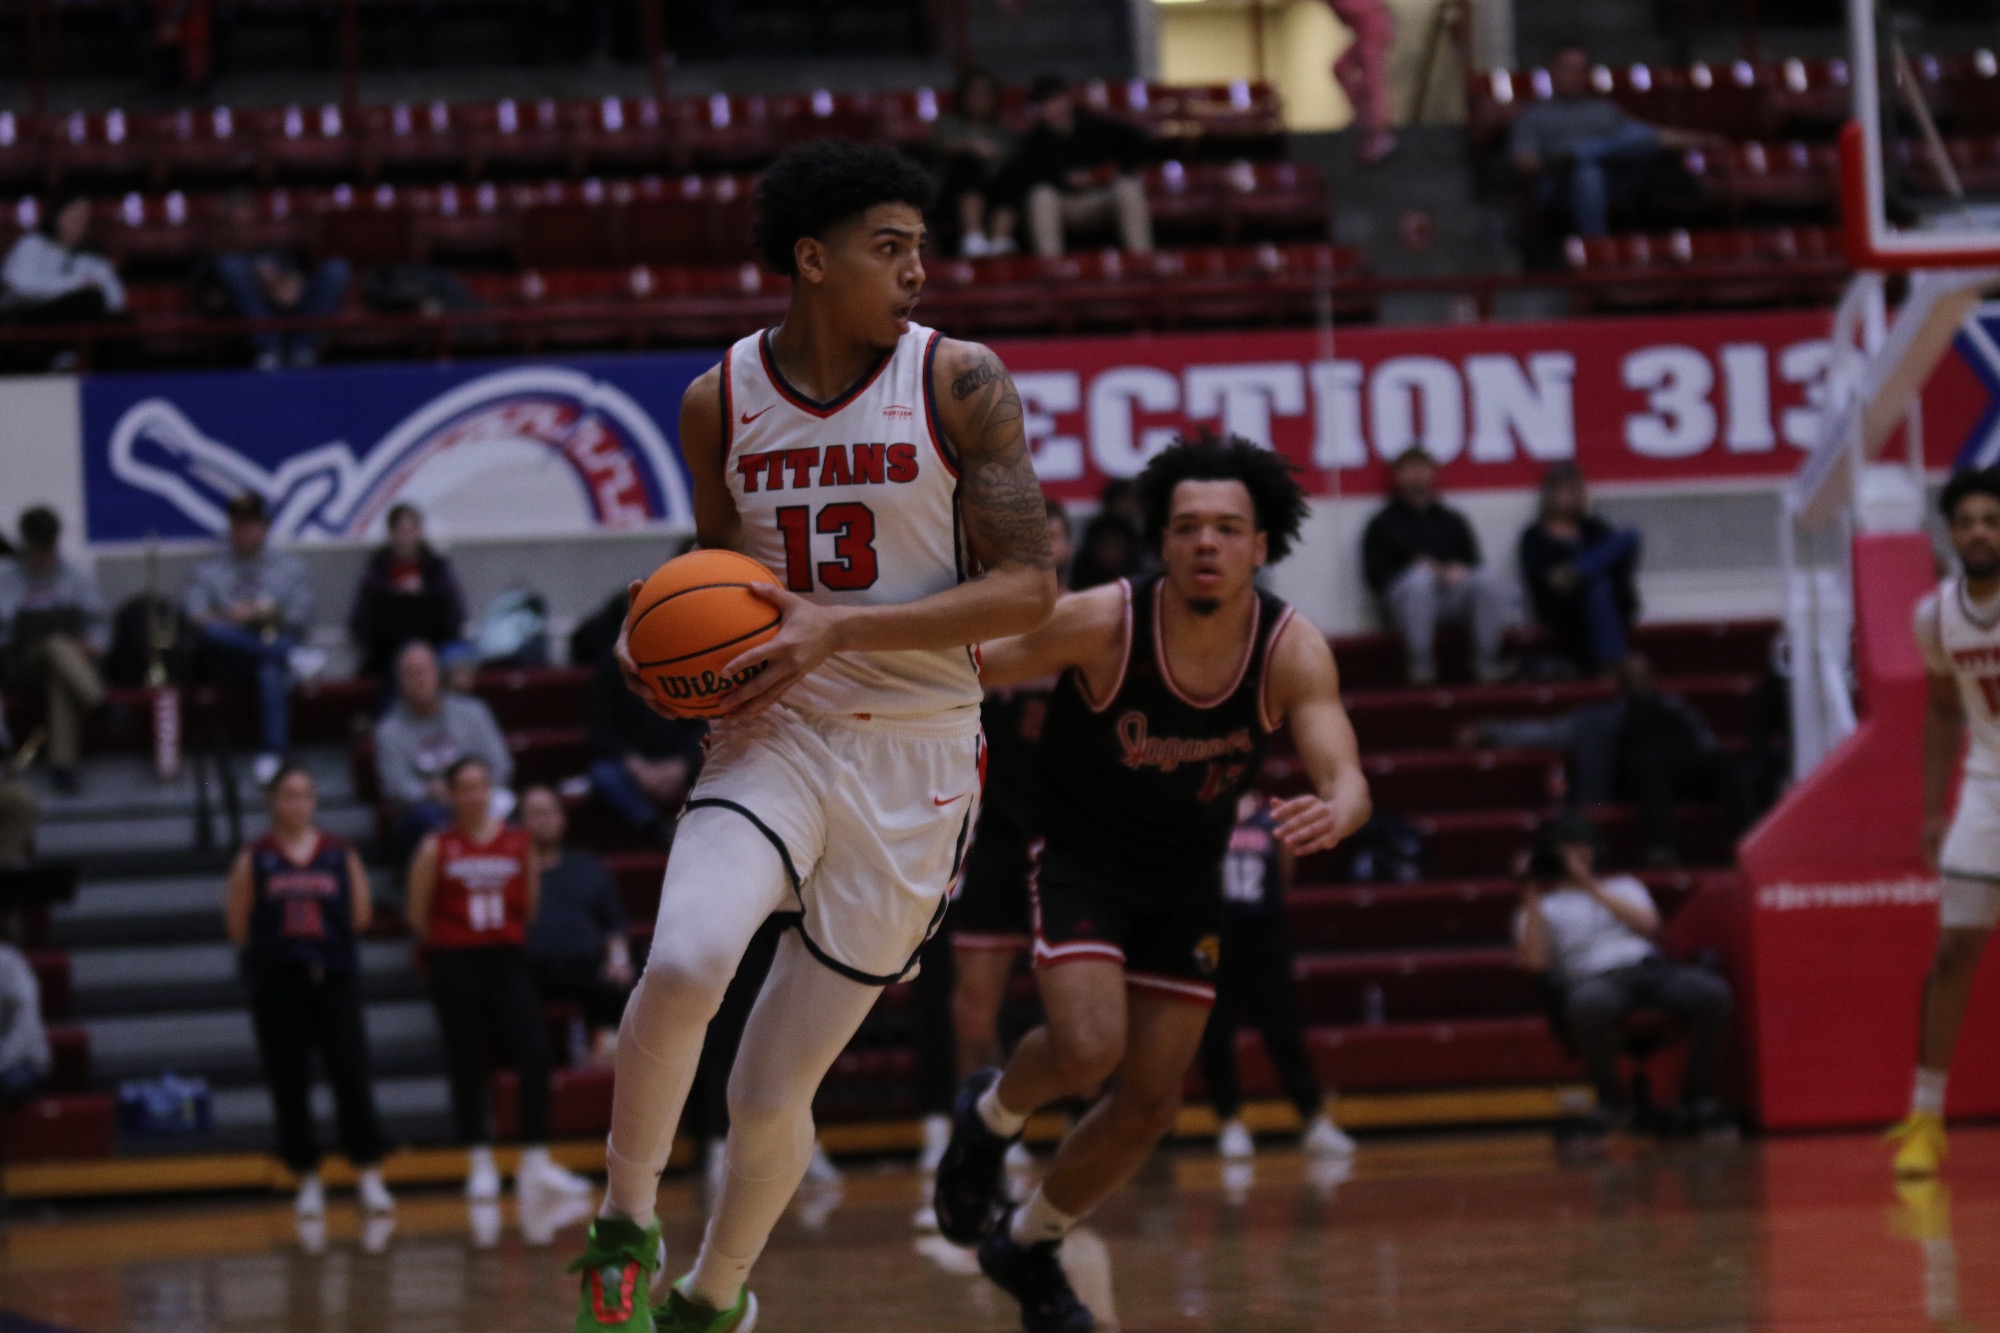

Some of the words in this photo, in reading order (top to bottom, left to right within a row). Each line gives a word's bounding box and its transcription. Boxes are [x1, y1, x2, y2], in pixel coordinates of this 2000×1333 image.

[1014, 352, 1576, 481] ECTION
[1619, 338, 1838, 459] 313
[737, 443, 919, 493] TITANS
[776, 502, 879, 592] 13
